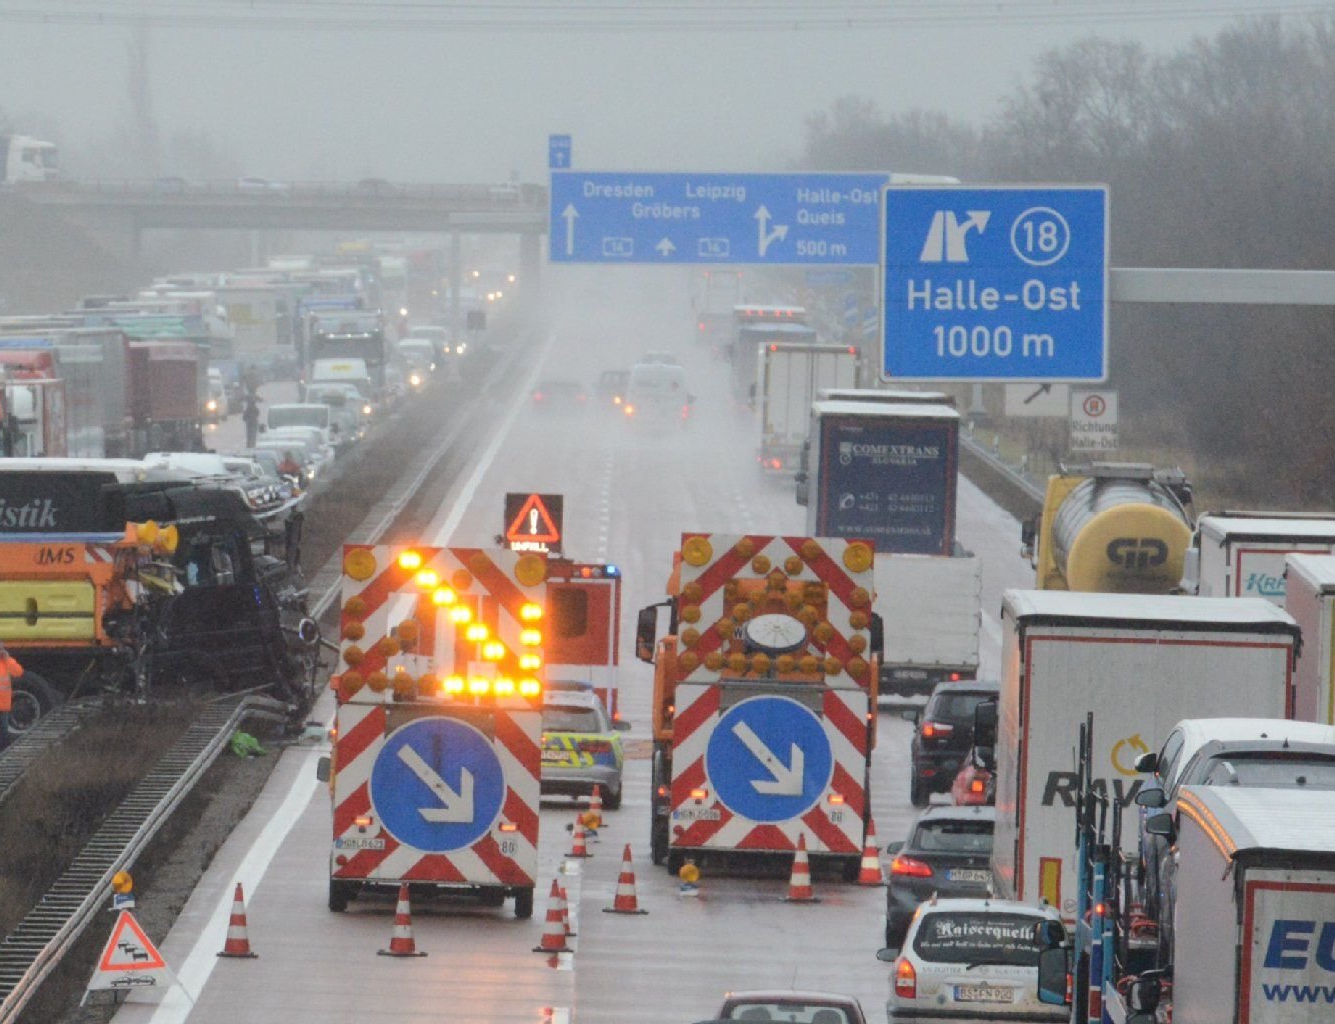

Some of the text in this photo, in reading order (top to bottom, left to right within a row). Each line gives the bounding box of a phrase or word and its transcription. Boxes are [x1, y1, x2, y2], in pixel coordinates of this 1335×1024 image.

[583, 182, 654, 198] Dresden
[685, 182, 746, 202] Leipzig
[797, 188, 879, 205] Halle-Ost
[632, 202, 701, 220] Gröbers
[797, 209, 845, 226] Queis
[1021, 220, 1057, 253] 18
[797, 240, 847, 257] 500 m
[907, 280, 1081, 311] Halle-Ost
[934, 326, 1054, 358] 1000 m
[1072, 420, 1118, 434] Richtung
[852, 443, 940, 456] COMEXTRANS
